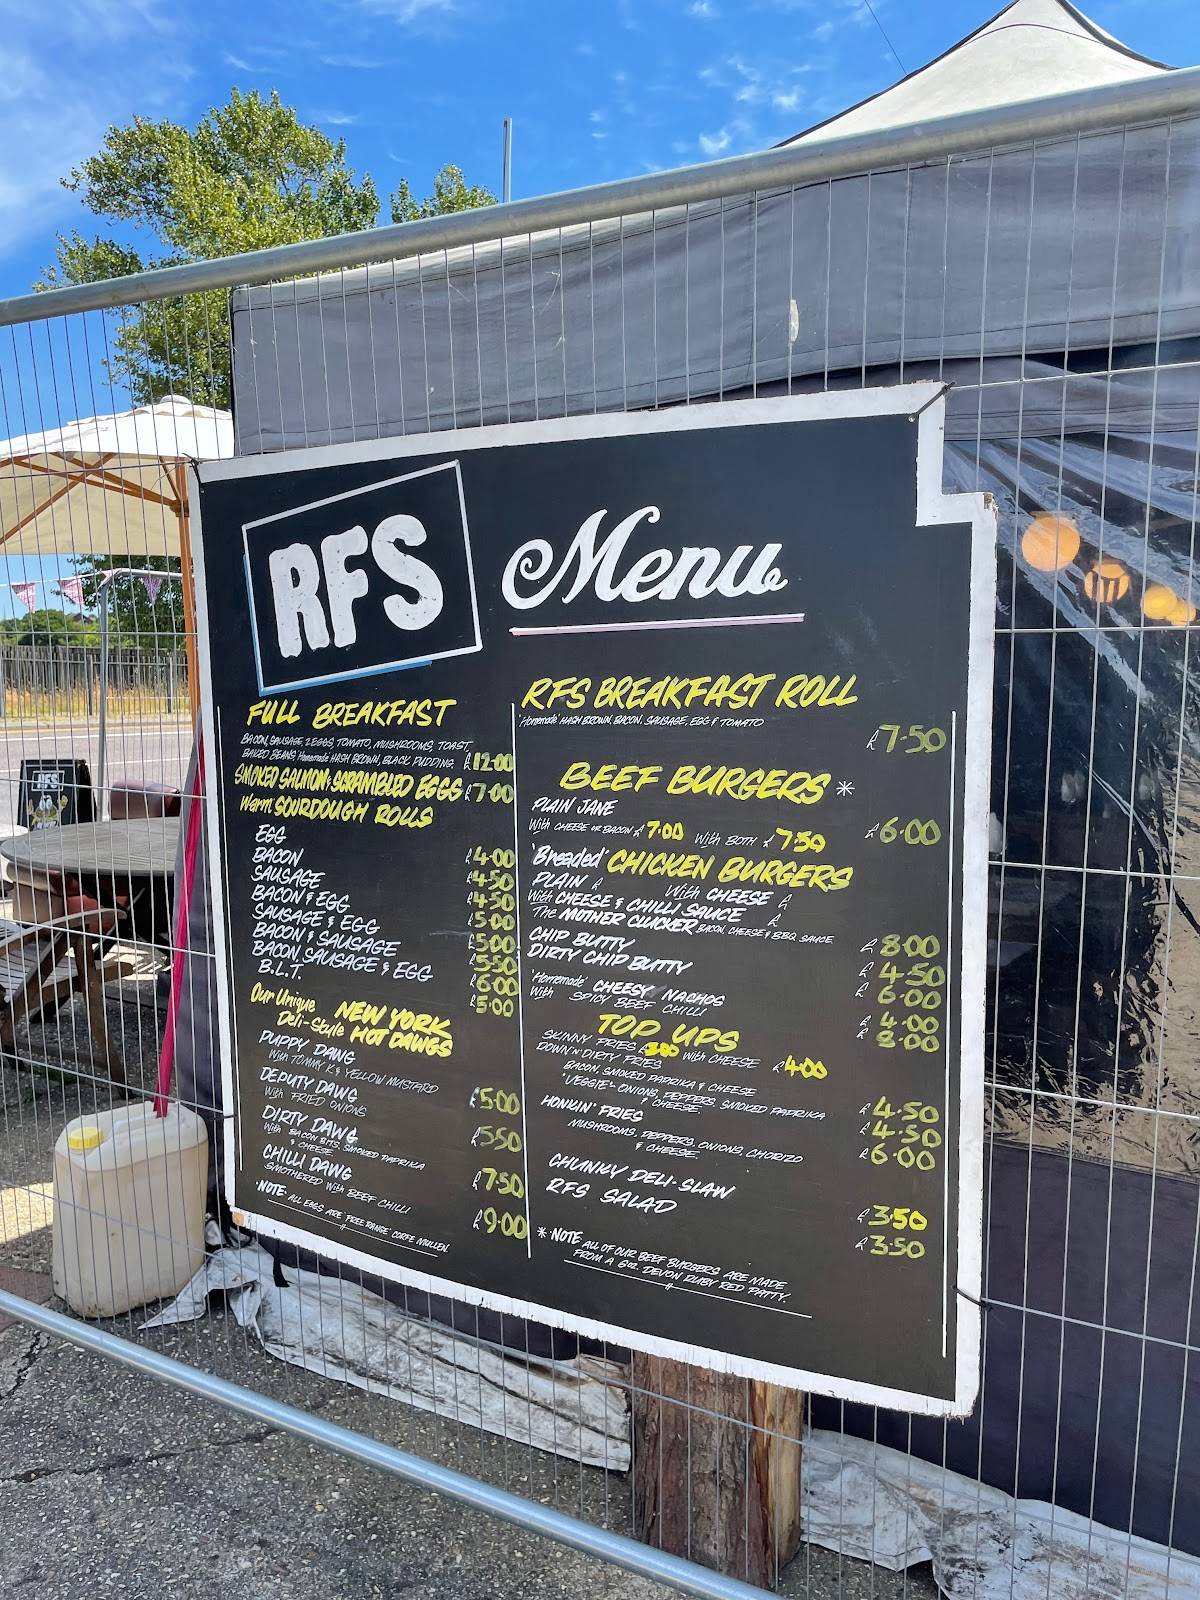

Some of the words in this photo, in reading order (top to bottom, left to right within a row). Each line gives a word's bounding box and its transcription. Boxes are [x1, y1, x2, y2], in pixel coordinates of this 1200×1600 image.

[269, 514, 443, 658] RFS
[502, 506, 788, 609] Menu
[521, 677, 592, 710] RFS
[594, 673, 776, 709] BREAKFAST
[775, 674, 858, 708] ROLL
[247, 700, 300, 725] FULL
[312, 699, 457, 729] BREAKFAST
[690, 717, 711, 726] EGG
[720, 719, 764, 727] TOMATO
[241, 748, 269, 758] BAKED
[382, 755, 411, 766] BLACK
[235, 763, 278, 787] SMOKED
[279, 767, 329, 791] SALMON
[331, 770, 414, 799] SCRAMBLED
[415, 775, 462, 802] EGGS
[559, 762, 663, 792] BEEF
[666, 764, 831, 805] BURGERS
[240, 794, 275, 813] Warm
[275, 798, 370, 823] SOURDOUGH
[374, 803, 434, 827] ROLLS
[532, 796, 576, 814] PLAIN
[576, 799, 618, 816] JANE
[255, 824, 286, 845] EGG
[528, 817, 550, 835] With
[554, 823, 590, 831] CHEESE
[602, 824, 633, 834] BACON
[695, 832, 721, 848] With
[725, 833, 758, 846] BOTH
[252, 848, 304, 866] BACON
[606, 849, 715, 880] CHICKEN
[717, 856, 854, 892] BURGERS
[251, 866, 325, 889] SAUSAGE
[532, 871, 588, 889] PLAIN
[665, 883, 700, 900] With
[706, 888, 774, 905] CHEESE
[252, 885, 304, 905] BACON
[316, 891, 350, 913] EGG
[555, 891, 613, 908] CHEESE
[625, 899, 681, 915] CHILLI
[681, 904, 747, 922] SAUCE
[252, 904, 324, 928] SAUSAGE
[340, 915, 380, 935] EGG
[533, 905, 557, 919] The
[559, 907, 625, 926] MOTHER
[627, 914, 699, 935] CLUCKER
[728, 927, 765, 938] CHEESE
[771, 931, 796, 942] BBQ
[799, 934, 834, 944] SAUCE
[253, 922, 306, 942] BACON
[316, 931, 401, 957] SAUSAGE
[529, 926, 570, 941] CHIP
[572, 932, 636, 952] BUTTY
[258, 959, 303, 980] B.L.T.
[302, 947, 380, 973] SAUSAGE
[393, 962, 433, 982] EGG
[527, 943, 582, 961] DIRTY
[583, 951, 629, 966] CHIP
[627, 956, 693, 975] BUTTY
[529, 986, 554, 1000] With
[569, 992, 612, 1005] SPICY
[614, 997, 656, 1010] BEEF
[662, 1005, 707, 1017] CHILLI
[593, 980, 655, 998] CHEESY
[661, 988, 725, 1006] NACHOS
[250, 982, 274, 1004] Our
[275, 987, 316, 1013] Unique
[334, 1001, 387, 1025] NEW
[390, 1007, 450, 1038] YORK
[259, 1030, 310, 1053] PUPPY
[312, 1043, 355, 1065] DAWG
[349, 1025, 389, 1047] HOT
[388, 1032, 453, 1057] DAWGS
[598, 1014, 661, 1039] TOP
[671, 1024, 740, 1052] UPS
[542, 1030, 593, 1044] SKINNY
[596, 1038, 637, 1051] FRIES
[708, 1055, 761, 1069] CHEESE
[581, 1049, 622, 1061] DIRTY
[624, 1055, 662, 1070] FRIES
[259, 1067, 314, 1089] DEPUTY
[315, 1080, 358, 1102] DAWG
[291, 1053, 325, 1070] TOMMY
[345, 1068, 385, 1085] YELLOW
[385, 1077, 439, 1094] MUSTARD
[602, 1066, 647, 1080] SMOKED
[648, 1074, 696, 1090] PAPRIKA
[707, 1084, 757, 1097] CHEESE
[291, 1091, 326, 1107] FRIED
[329, 1100, 367, 1118] ONIONS
[598, 1105, 644, 1122] FRIES
[720, 1101, 768, 1114] SMOKED
[769, 1107, 826, 1120] PAPRIKA
[261, 1104, 310, 1128] DIRTY
[311, 1118, 359, 1144] DAWG
[262, 1144, 307, 1169] CHILLI
[309, 1157, 352, 1180] DAWG
[288, 1128, 318, 1142] BACON
[343, 1144, 380, 1160] SMOKED
[381, 1154, 427, 1170] PAPRIKA
[746, 1149, 803, 1163] CHORIZO
[549, 1153, 629, 1179] CHUNKY
[263, 1161, 322, 1186] SMOTHERED
[346, 1189, 377, 1203] BEEF
[379, 1199, 411, 1215] CHILLI
[546, 1178, 591, 1198] RFS
[600, 1188, 677, 1213] SALAD
[288, 1193, 302, 1205] ALL
[303, 1198, 324, 1213] EGGS
[325, 1206, 342, 1220] ARE
[573, 1249, 602, 1262] FROM
[642, 1265, 683, 1280] DEVON
[683, 1274, 717, 1287] RUBY
[582, 1240, 600, 1250] ALL
[600, 1243, 615, 1252] OF
[615, 1247, 638, 1258] OUR
[638, 1251, 667, 1264] BEEF
[666, 1258, 721, 1275] BURGERS
[723, 1270, 749, 1281] ARE
[749, 1277, 788, 1290] MADE
